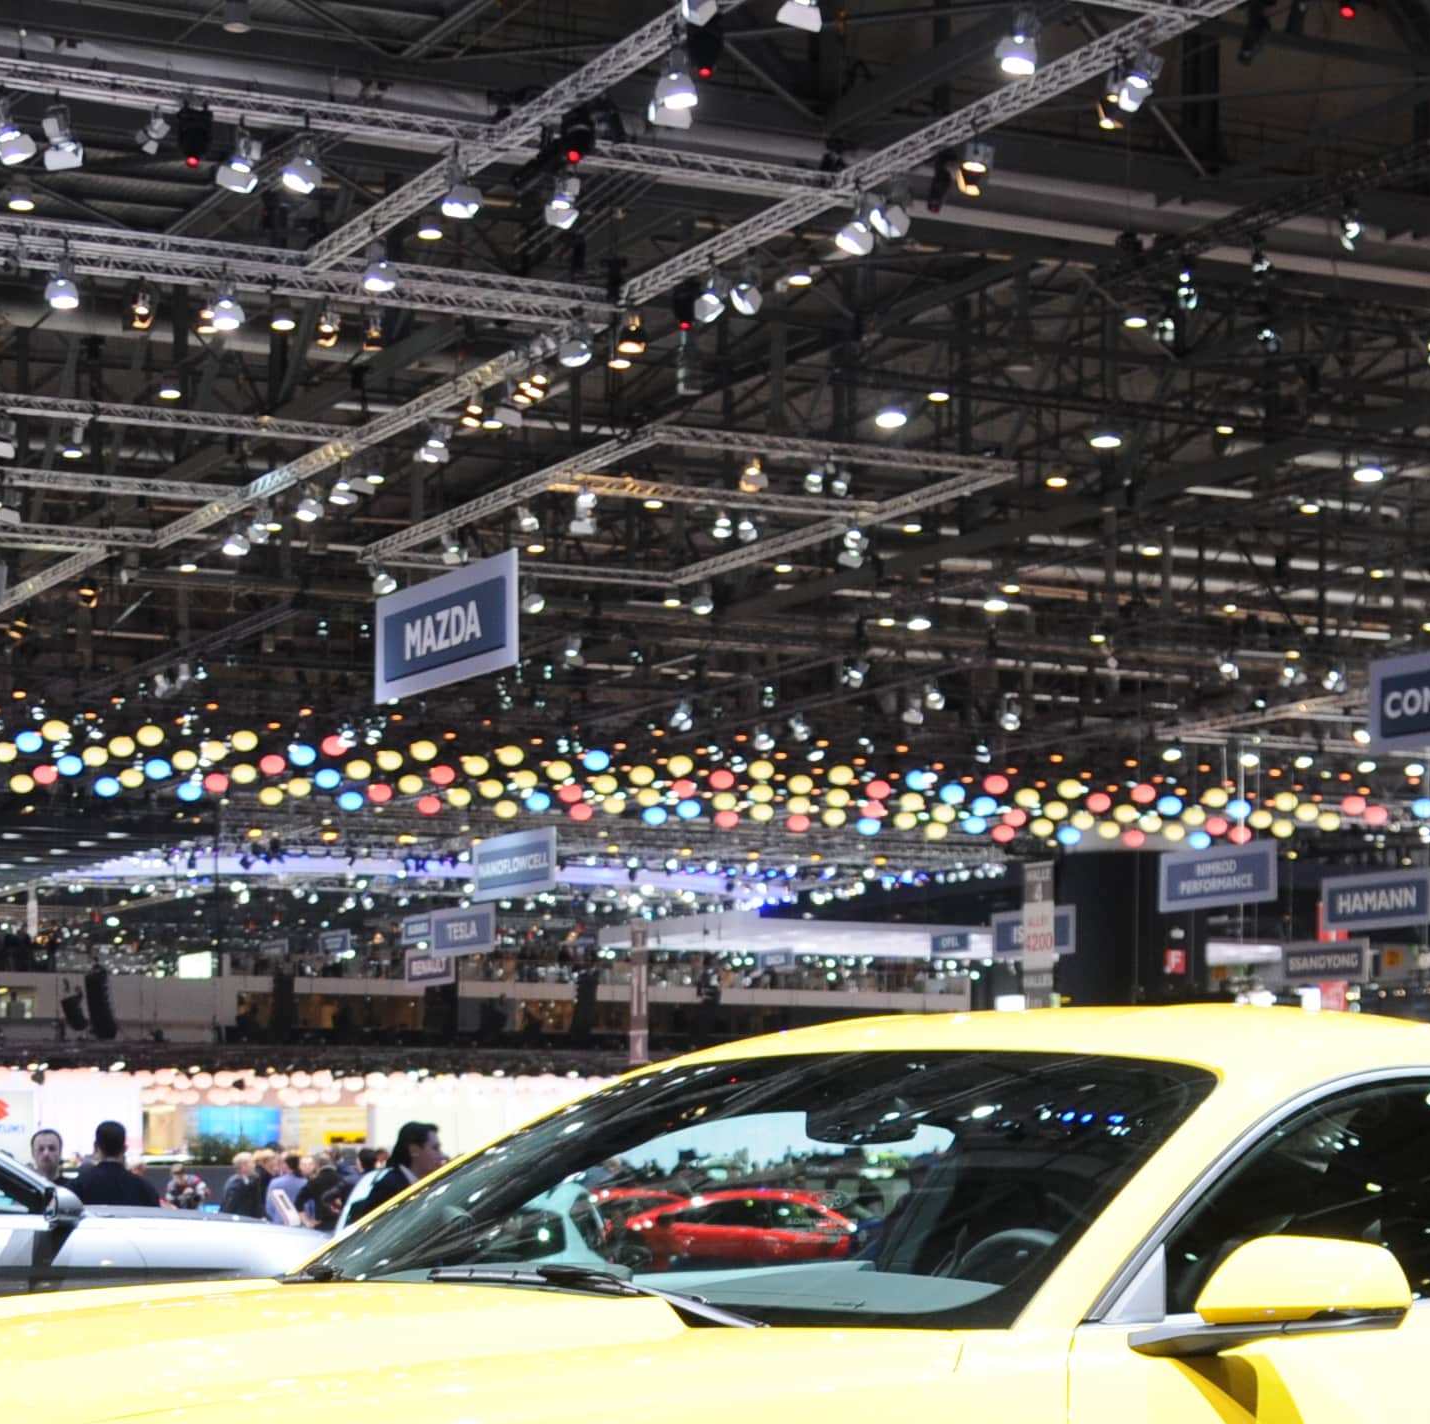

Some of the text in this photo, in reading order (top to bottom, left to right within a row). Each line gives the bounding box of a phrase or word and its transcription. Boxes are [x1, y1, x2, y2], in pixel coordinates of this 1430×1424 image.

[403, 600, 482, 662] MAZDA
[1196, 859, 1238, 877] NIMROD
[1179, 873, 1254, 895] PERFORMANCE
[1337, 886, 1417, 914] HAMANN
[446, 921, 478, 942] TESLA
[1025, 933, 1053, 950] 4200
[1288, 953, 1359, 971] SSANGYONG
